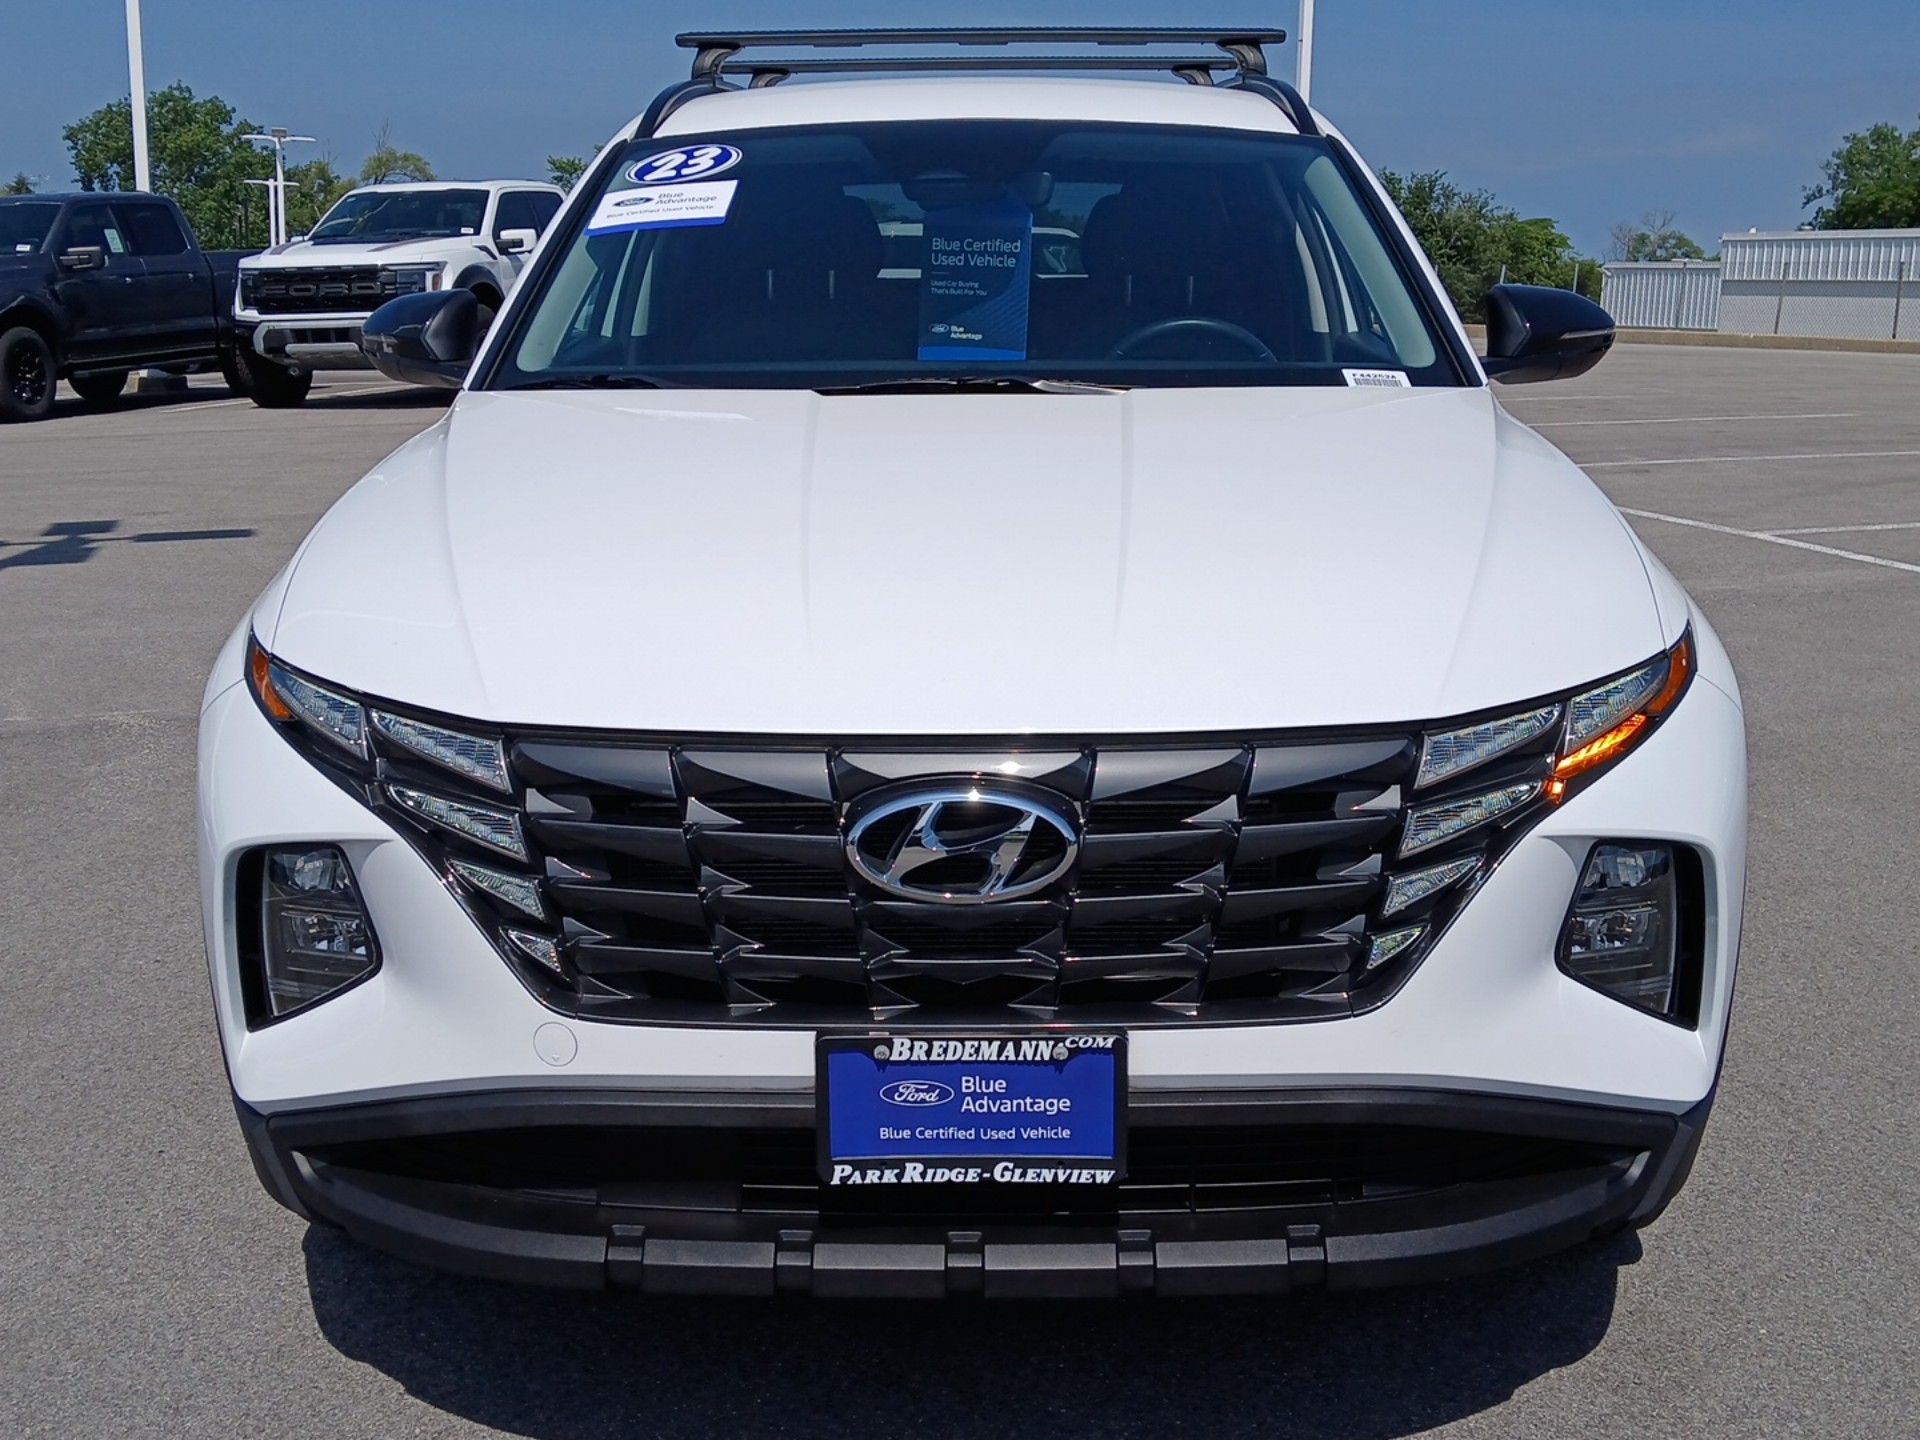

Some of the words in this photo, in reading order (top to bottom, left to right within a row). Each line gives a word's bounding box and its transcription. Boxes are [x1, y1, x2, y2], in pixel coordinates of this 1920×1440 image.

[643, 147, 722, 181] 23
[655, 196, 718, 206] Advantage
[932, 238, 960, 251] Blue
[963, 239, 1021, 253] Certified
[931, 253, 964, 266] Used
[968, 254, 1016, 268] Vehicle
[958, 281, 980, 289] Buying
[950, 332, 983, 341] Advantage
[961, 1076, 1007, 1093] Blue
[894, 1084, 939, 1102] Ford
[960, 1096, 1071, 1115] Advantage
[879, 1127, 911, 1140] Blue
[915, 1126, 975, 1140] Certified
[980, 1127, 1016, 1140] Used
[1020, 1126, 1071, 1139] Vehicle
[830, 1164, 900, 1185] PARK
